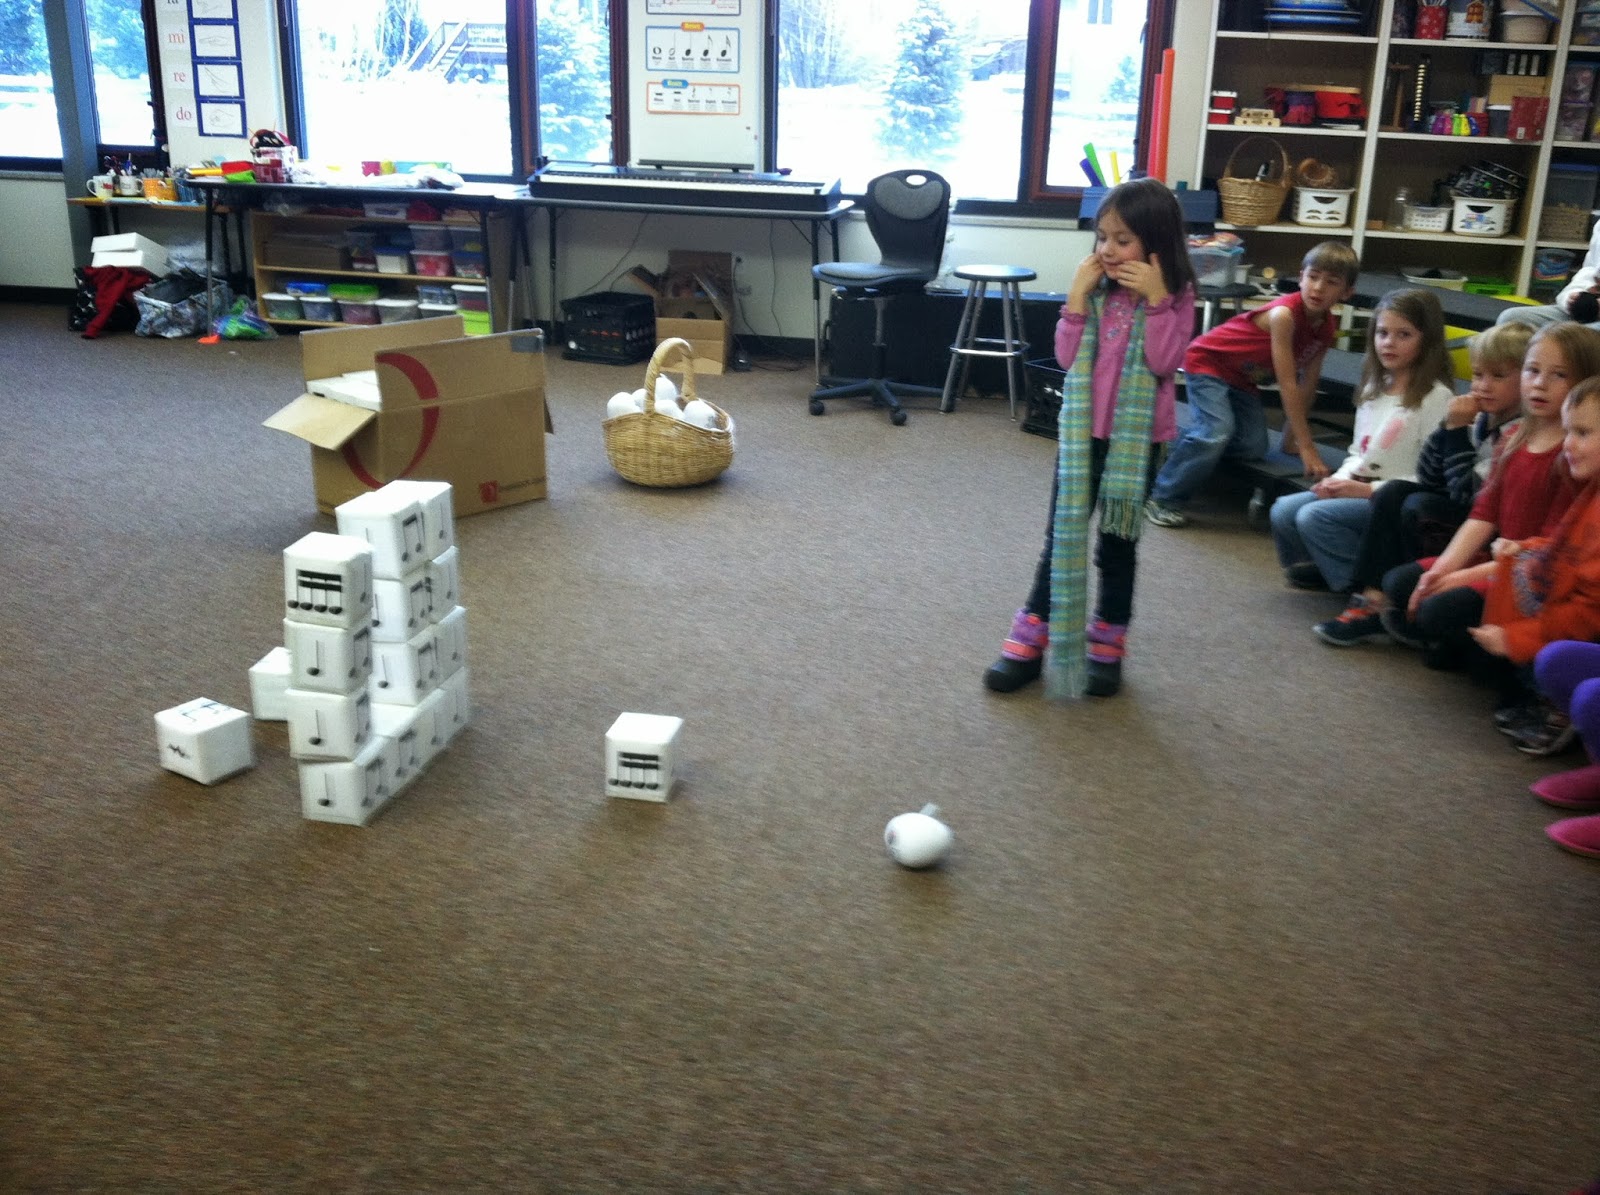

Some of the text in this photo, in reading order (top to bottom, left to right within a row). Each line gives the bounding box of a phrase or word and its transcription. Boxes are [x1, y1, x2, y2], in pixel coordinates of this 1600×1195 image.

[168, 29, 185, 44] mi
[173, 71, 186, 83] re
[176, 107, 192, 121] do
